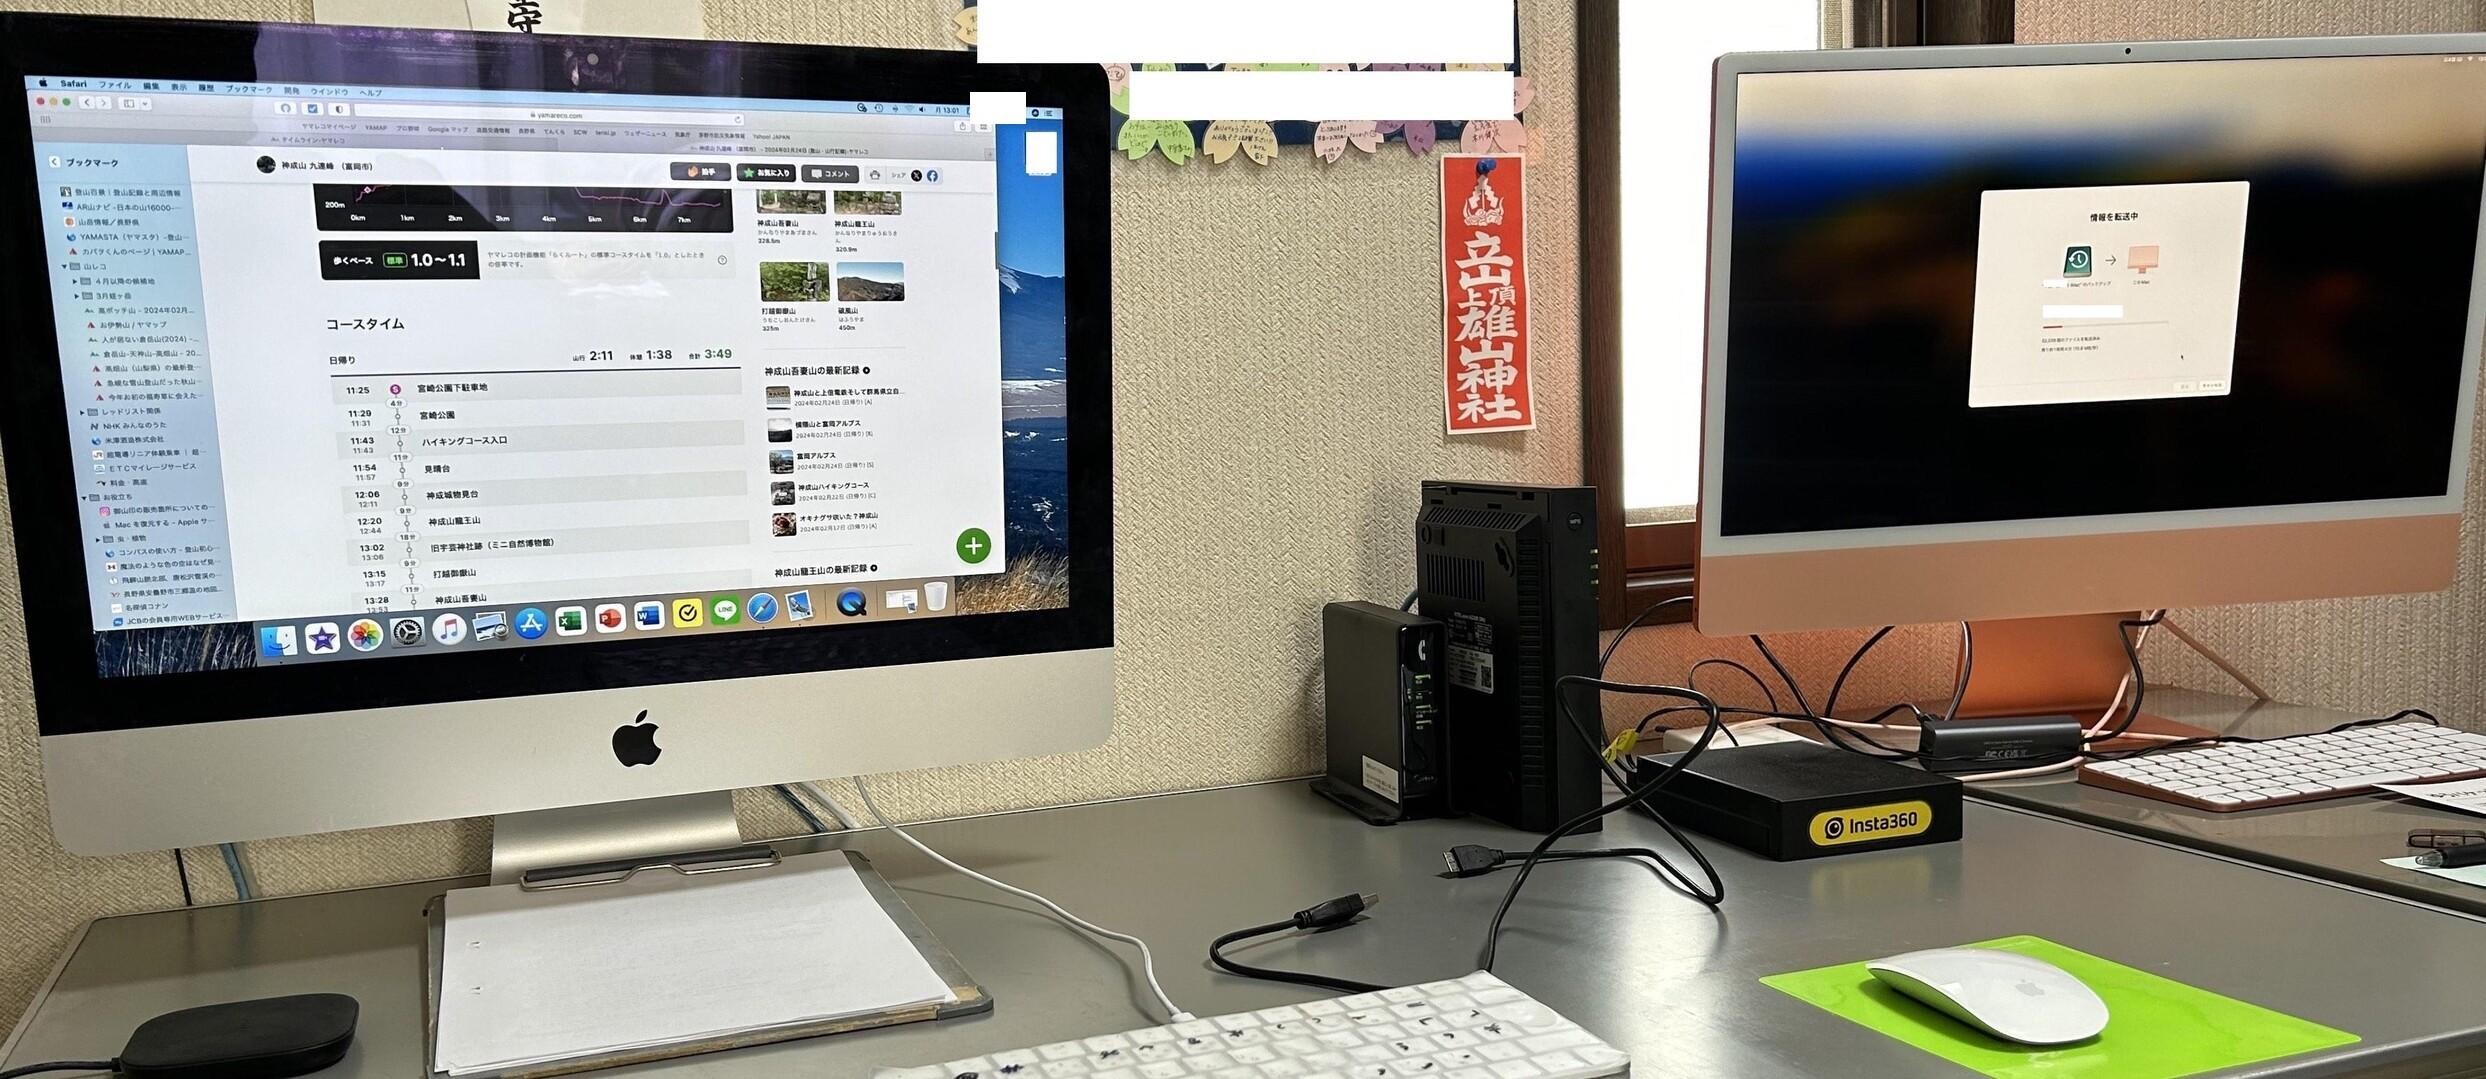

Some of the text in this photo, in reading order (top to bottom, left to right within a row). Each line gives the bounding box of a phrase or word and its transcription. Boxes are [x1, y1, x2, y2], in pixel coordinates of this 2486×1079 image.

[508, 0, 543, 33] 守
[60, 80, 87, 88] Safari
[100, 81, 132, 90] ファイル
[143, 82, 160, 91] 編集
[171, 83, 188, 91] 表示
[198, 84, 215, 92] 履歴
[226, 85, 273, 94] ブックマーク
[284, 87, 300, 95] 開発
[359, 89, 383, 97] ヘルプ
[66, 158, 119, 168] ブックマーク
[281, 161, 307, 171] 神成山
[757, 168, 790, 177] お気に入り
[824, 169, 850, 178] コメント
[325, 201, 346, 209] 200m
[350, 214, 366, 222] 0km
[400, 214, 415, 222] 1km
[2090, 211, 2139, 223] 情報を転送中
[333, 256, 374, 266] 歩くペース
[1455, 230, 1514, 291] 立山
[326, 318, 405, 331] コースタイム
[589, 350, 613, 361] 2:11
[646, 349, 673, 360] 1:38
[704, 348, 732, 359] 3:49
[329, 355, 356, 365] 日帰り
[1454, 304, 1523, 424] 雄山神社
[346, 383, 489, 395] 11:25 宮崎公園下駐車地
[419, 410, 456, 420] 宮崎公園
[350, 436, 507, 447] 11:43 ハイキングコース入口
[353, 464, 451, 474] 11:54 見晴台
[357, 517, 382, 525] 12:20
[360, 544, 385, 552] 13:02
[363, 570, 386, 578] 13:15
[364, 596, 389, 605] 13:28
[1848, 811, 1918, 834] Insta360
